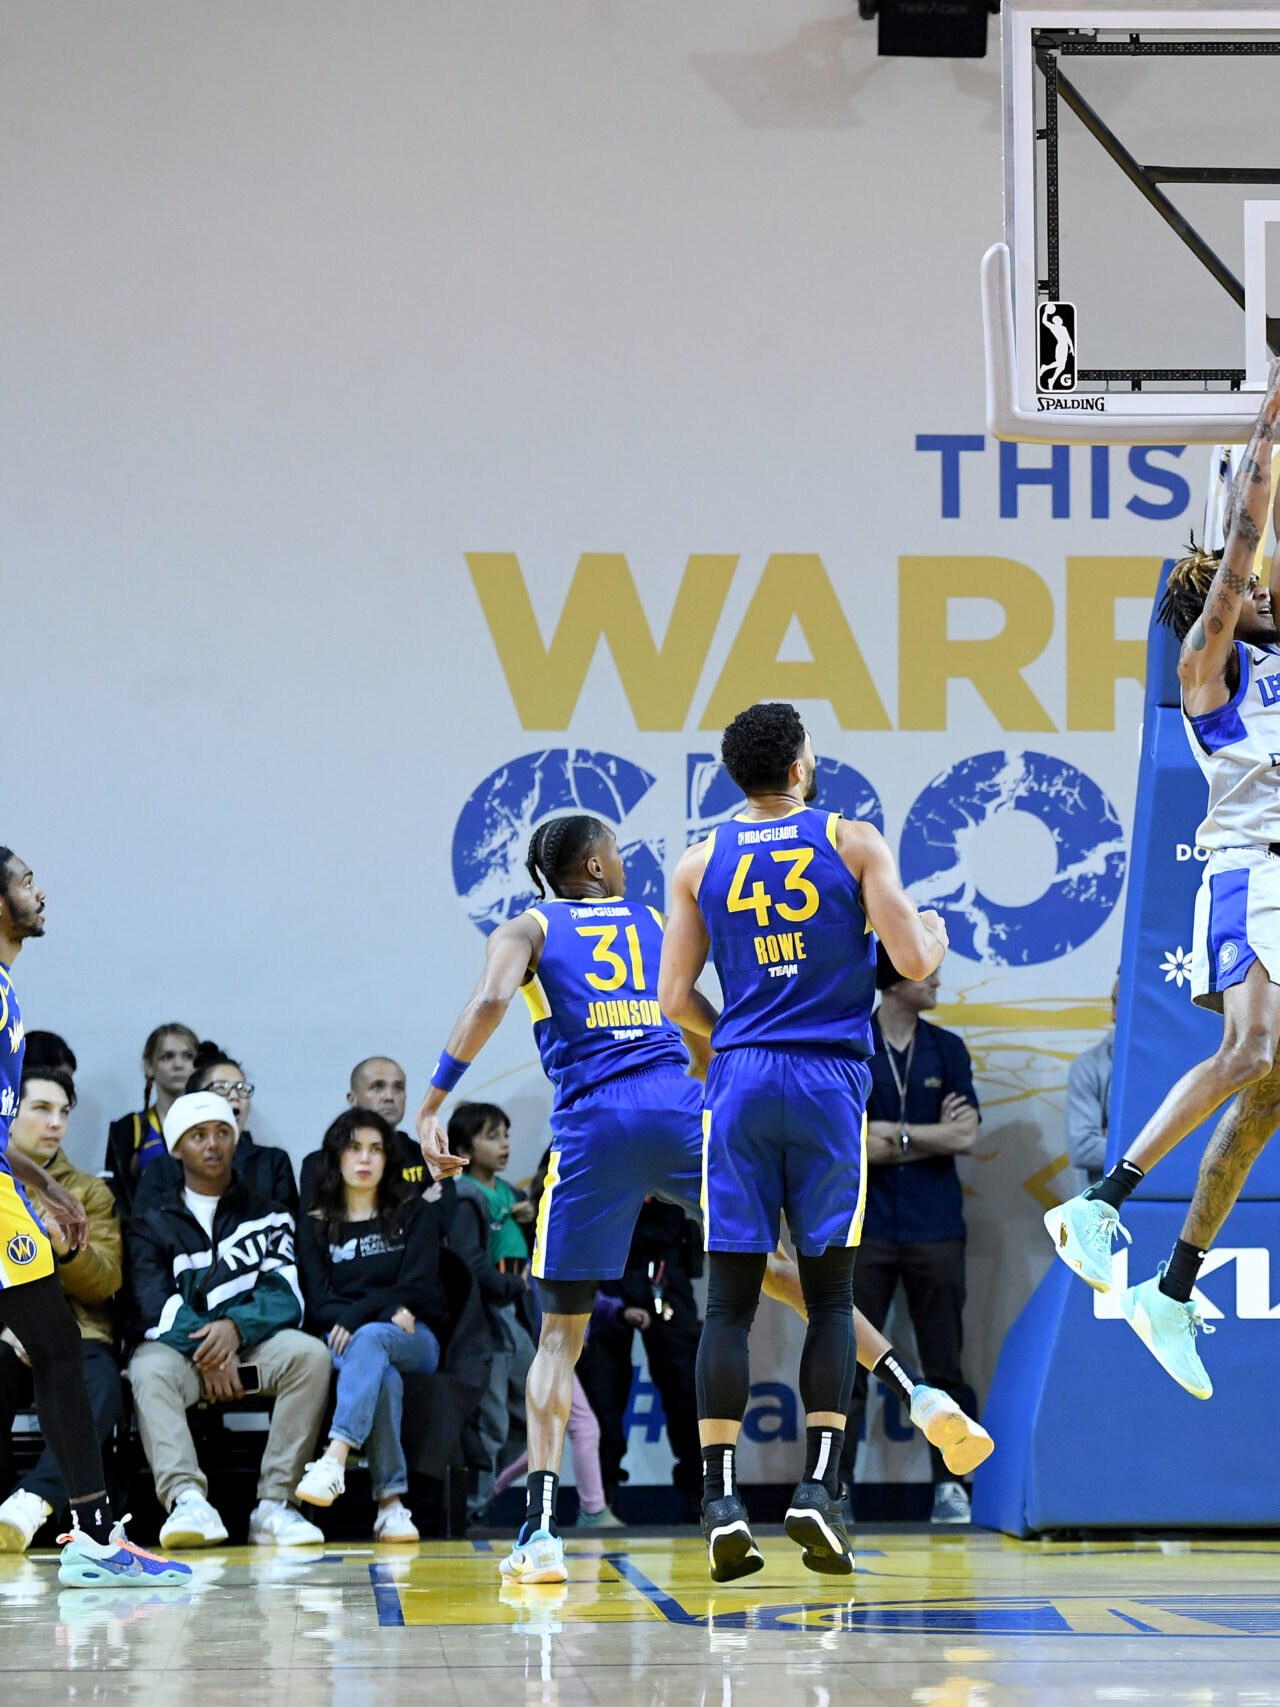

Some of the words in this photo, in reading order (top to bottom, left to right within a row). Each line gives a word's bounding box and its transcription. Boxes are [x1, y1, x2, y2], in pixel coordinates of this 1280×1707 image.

[1037, 396, 1105, 412] SPALDING
[915, 434, 1190, 520] THIS
[727, 847, 820, 927] 43
[575, 923, 646, 991] 31
[754, 931, 807, 965] ROWE
[768, 964, 798, 978] TEAM
[586, 1000, 662, 1029] JOHNSON
[223, 1229, 295, 1271] NIKE
